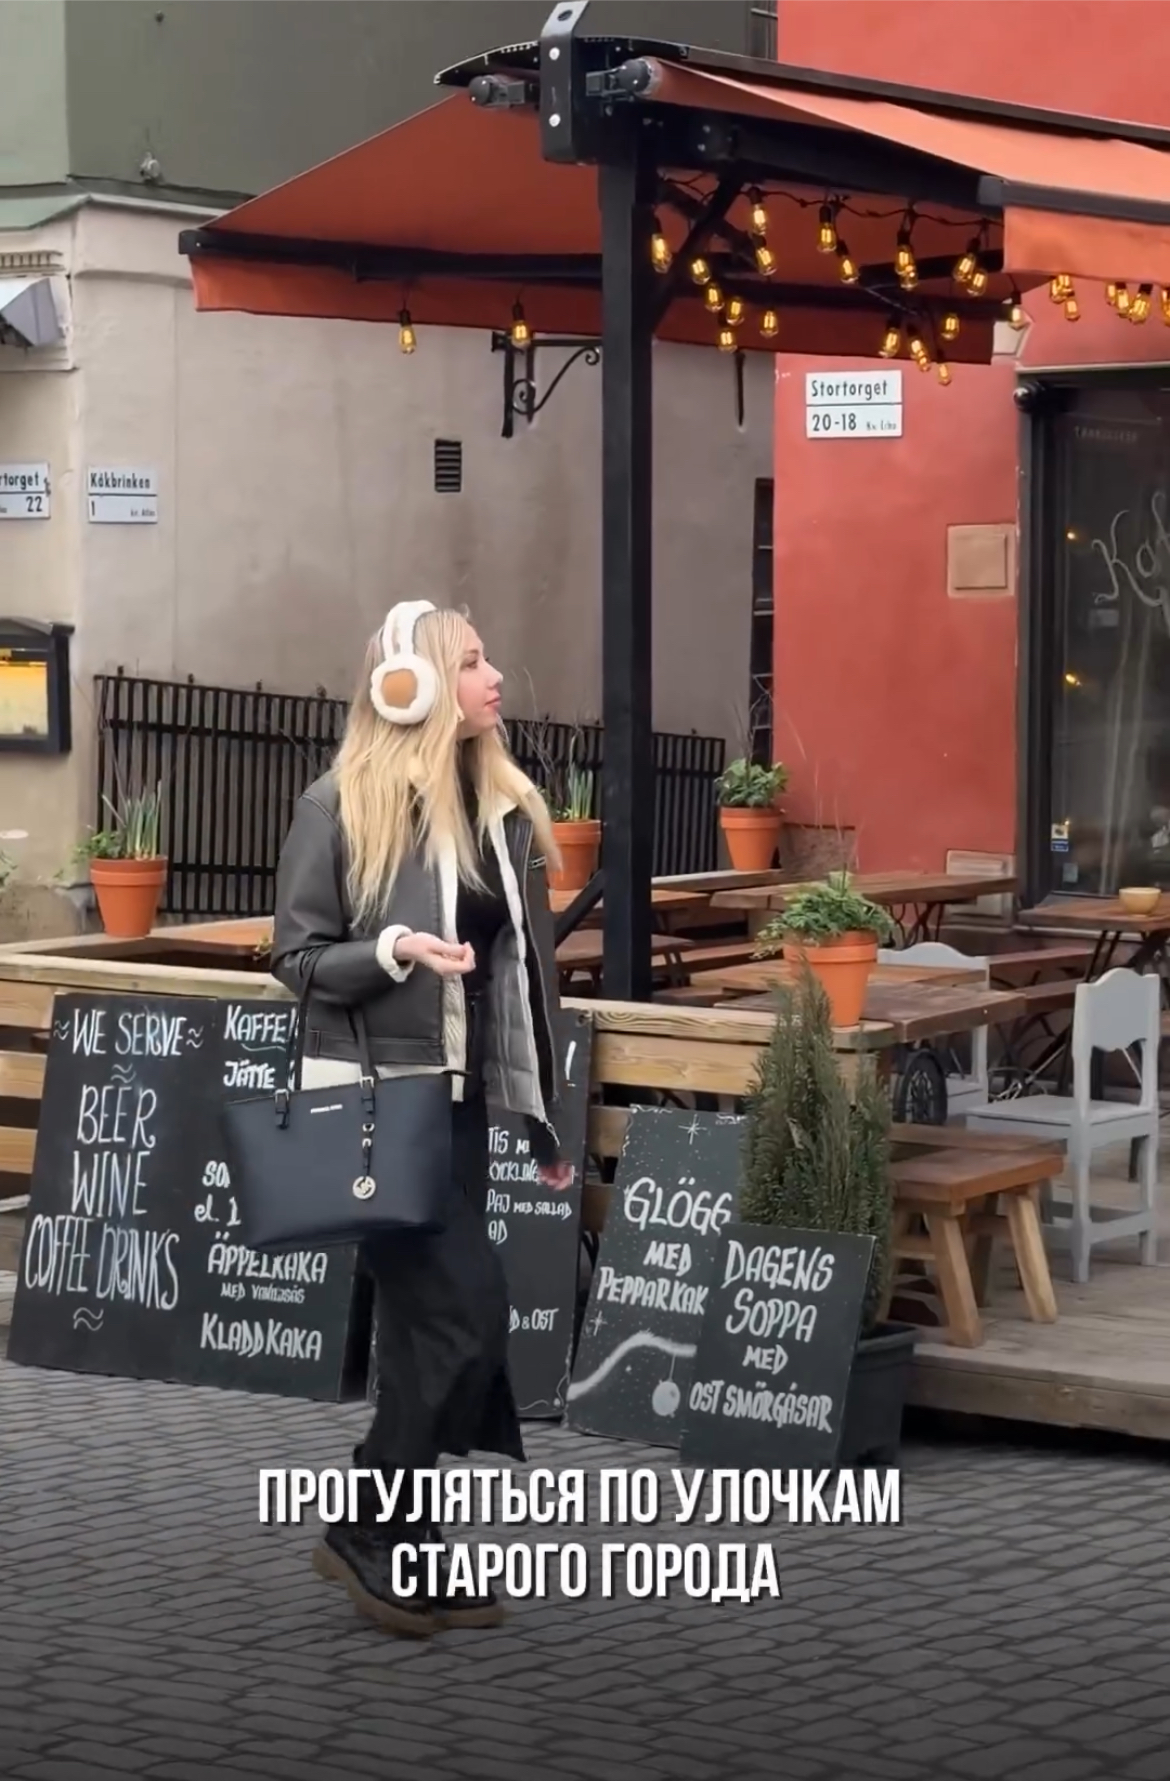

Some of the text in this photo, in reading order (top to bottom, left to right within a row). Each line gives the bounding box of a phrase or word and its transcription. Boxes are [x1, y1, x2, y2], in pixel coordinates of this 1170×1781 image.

[811, 379, 888, 401] Stortorget
[811, 412, 857, 432] 20-18
[26, 495, 43, 513] 22
[72, 1008, 187, 1057] WE SERVE
[223, 1059, 276, 1089] JÄTTE
[76, 1085, 157, 1149] BEER
[71, 1151, 151, 1218] WINE
[623, 1176, 733, 1236] GLÖGG
[25, 1214, 180, 1311] COFFEE DRINKS
[207, 1231, 329, 1284] ÄPPELKAKA
[642, 1240, 693, 1277] MED
[720, 1240, 835, 1292] DAGENS
[220, 1282, 246, 1302] MED
[596, 1266, 710, 1316] PEPPARKAK
[725, 1287, 818, 1343] SOPPA
[531, 1307, 560, 1332] OST
[742, 1344, 789, 1375] MED
